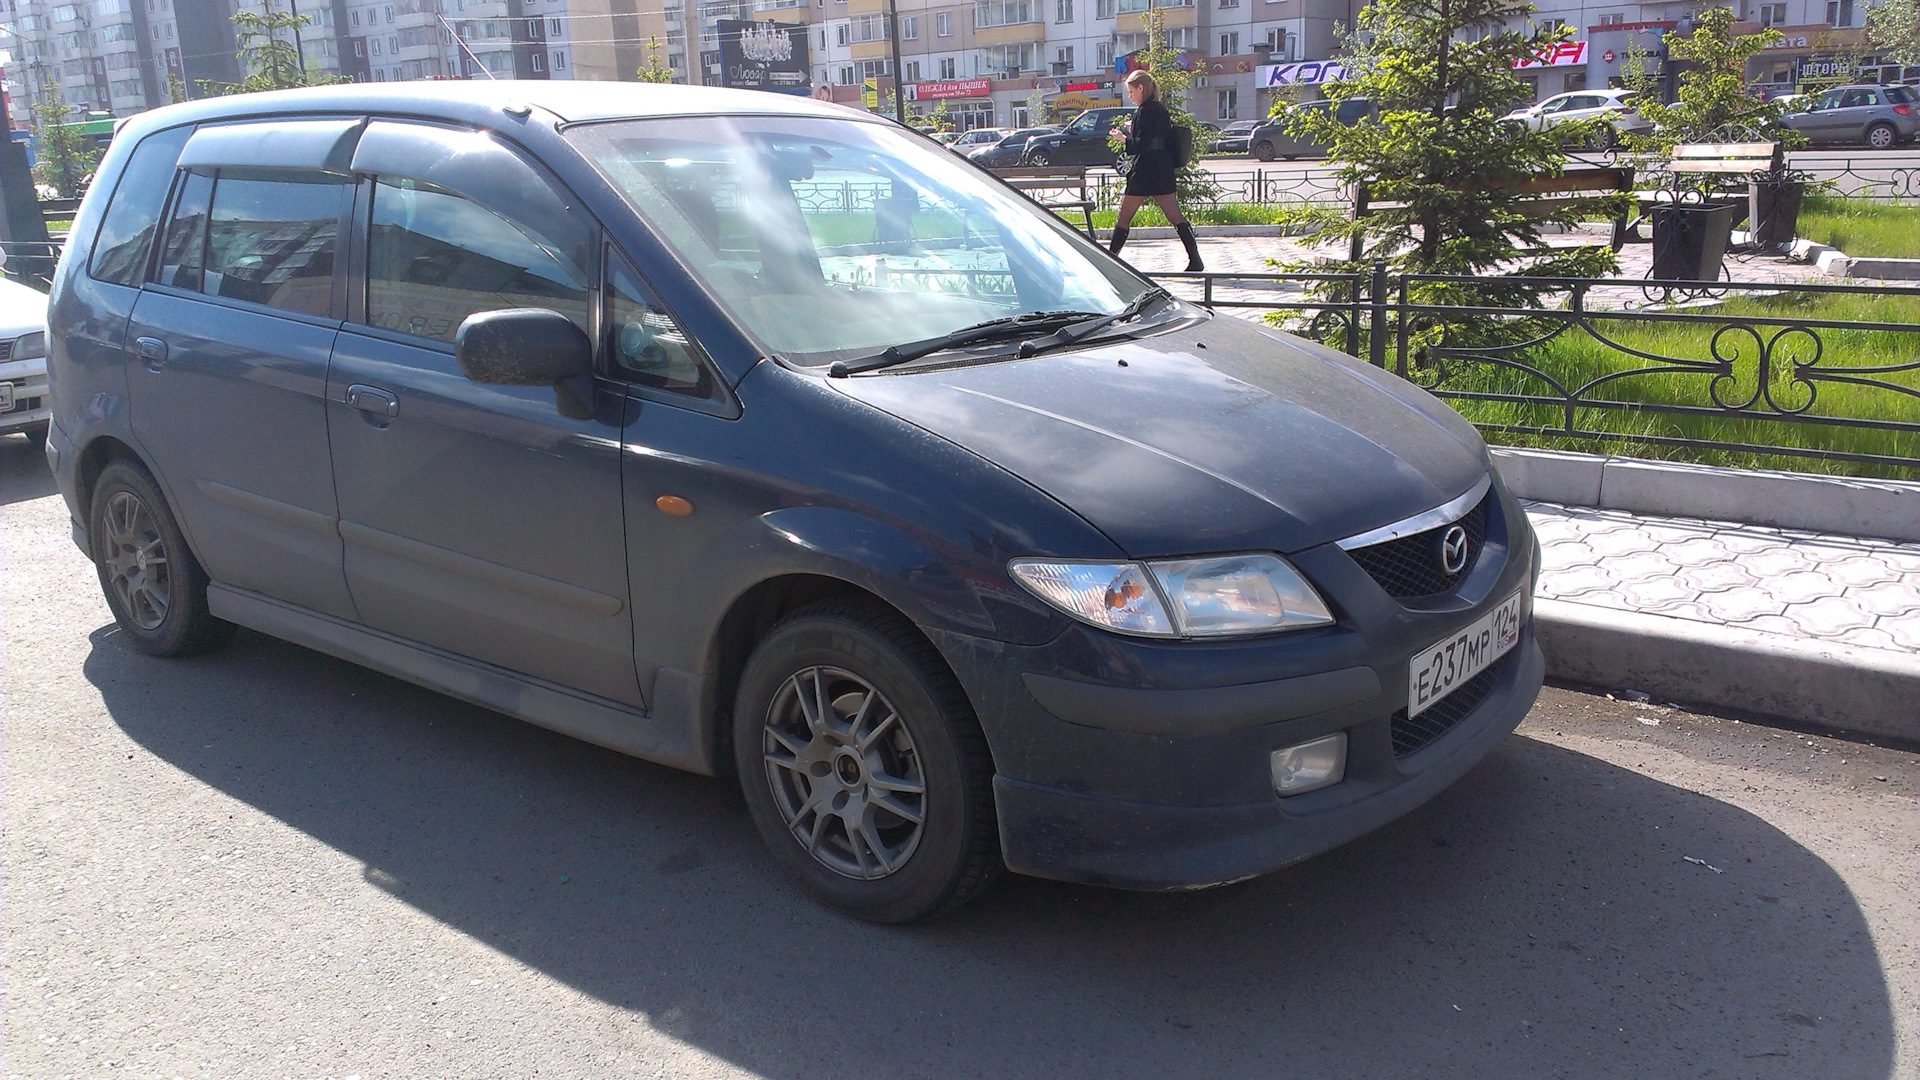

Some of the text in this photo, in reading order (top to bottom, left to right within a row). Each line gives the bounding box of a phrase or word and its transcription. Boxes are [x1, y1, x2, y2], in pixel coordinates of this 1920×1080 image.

[1802, 62, 1850, 75] ШТОРЫ
[918, 83, 946, 93] ОДЕЖДА
[958, 80, 987, 90] ПЫШЕК
[1056, 97, 1088, 108] Ламинат
[1494, 599, 1517, 641] 124
